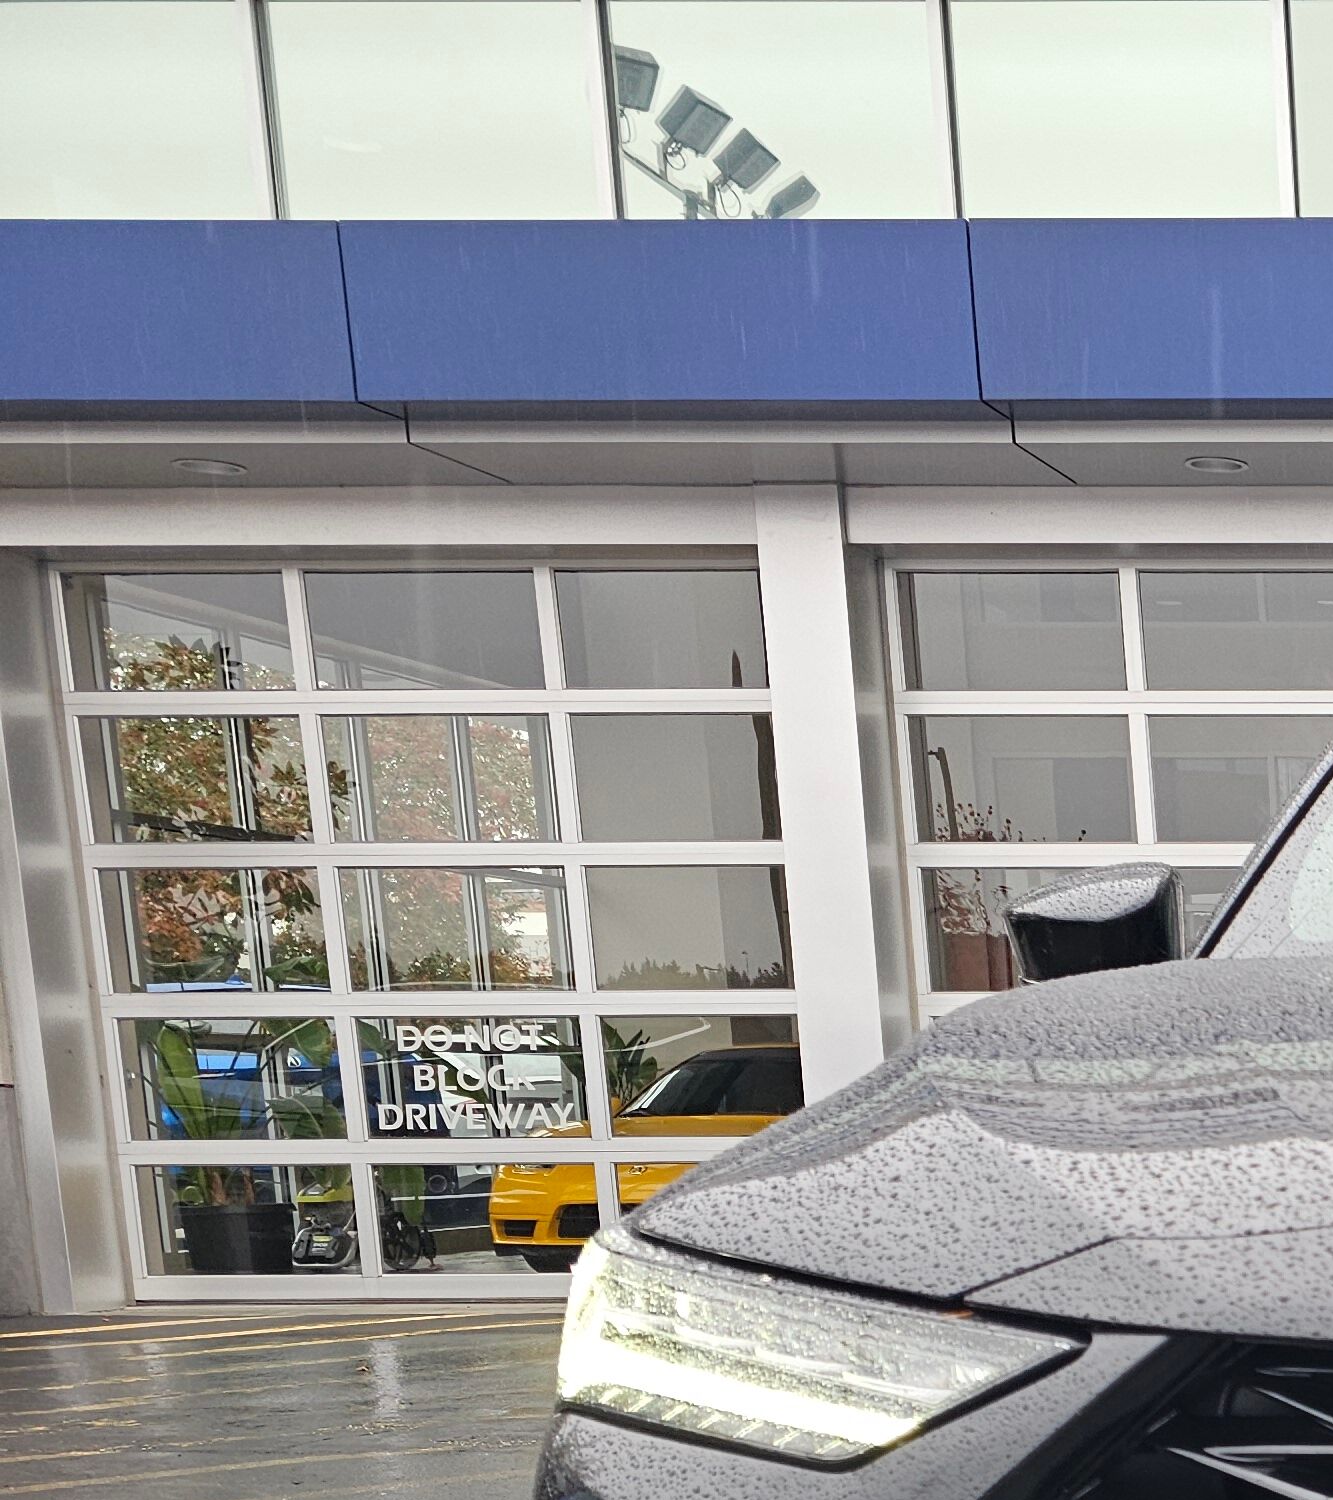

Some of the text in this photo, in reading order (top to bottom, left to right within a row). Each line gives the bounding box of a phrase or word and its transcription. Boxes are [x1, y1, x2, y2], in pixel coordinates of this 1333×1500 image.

[396, 1023, 544, 1053] DO NOT
[412, 1063, 537, 1092] BLOCK
[376, 1101, 575, 1131] DRIVEWAY
